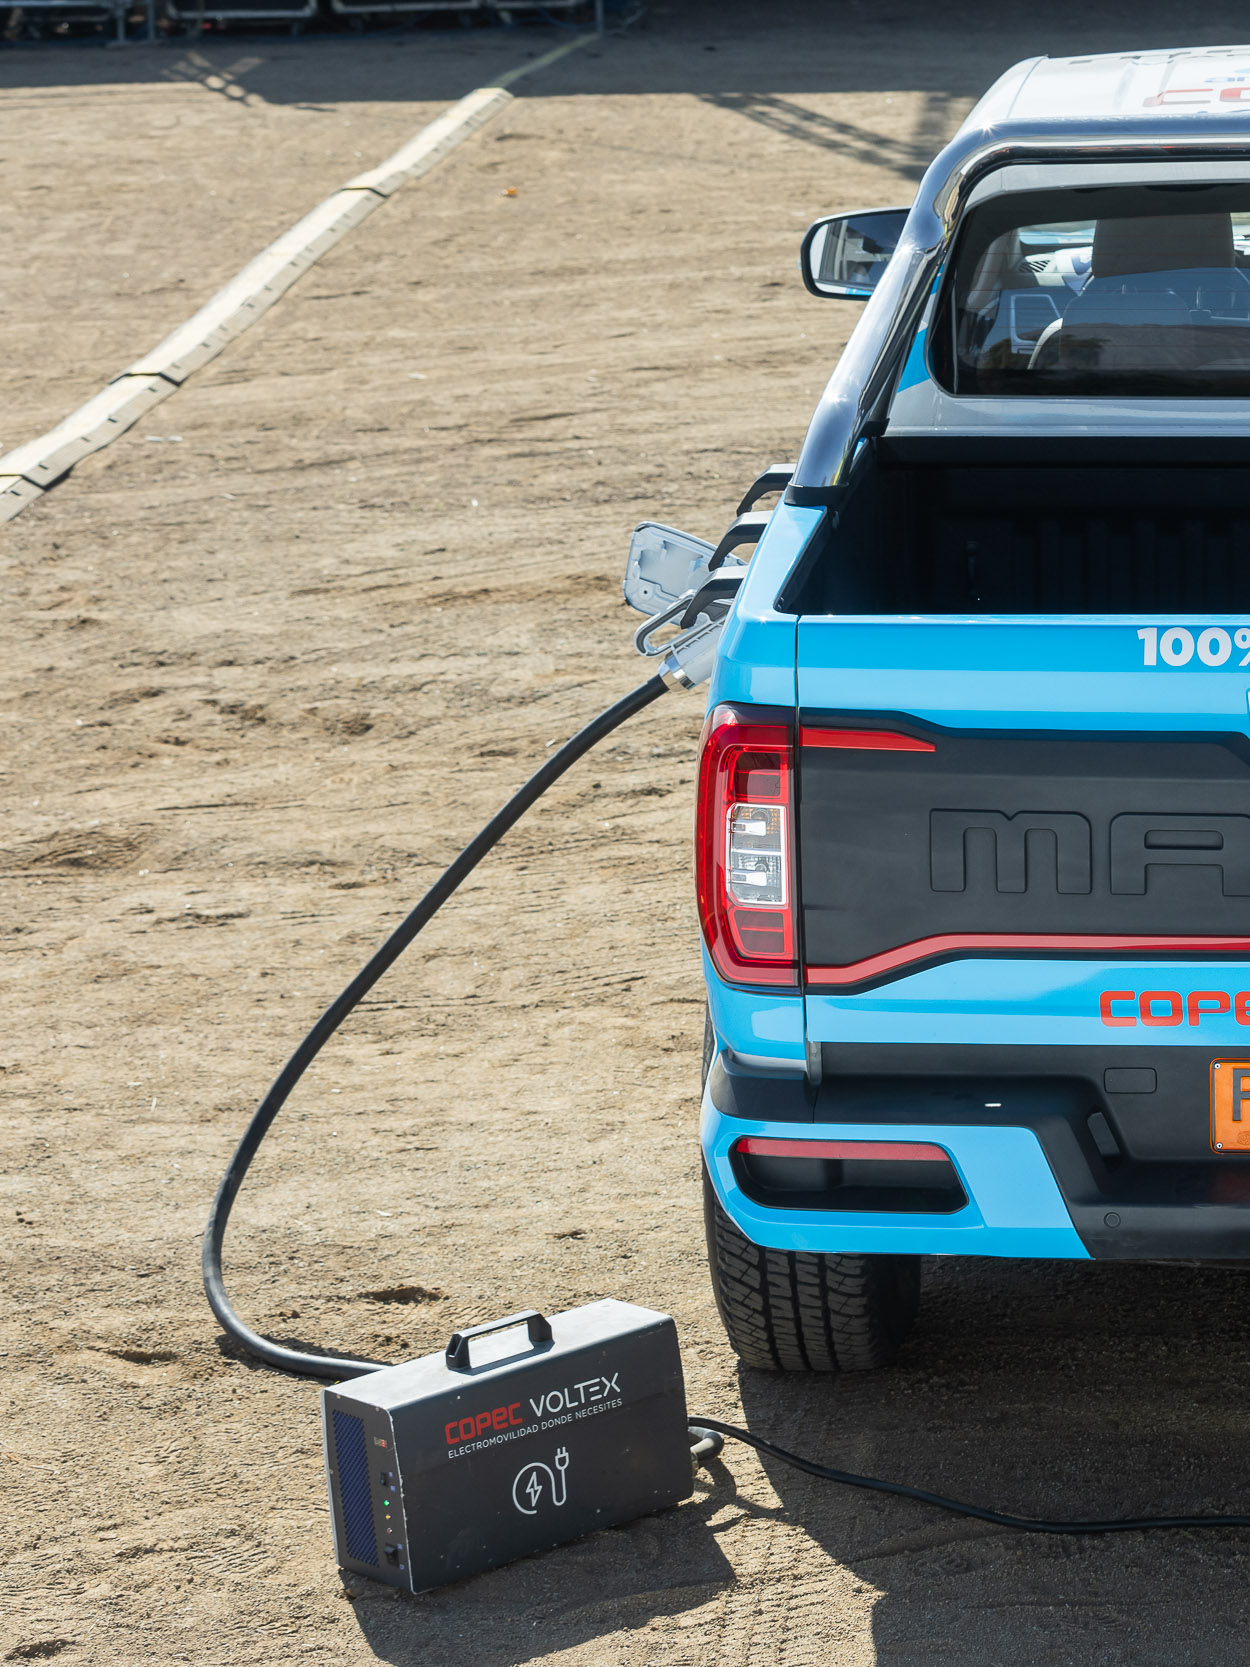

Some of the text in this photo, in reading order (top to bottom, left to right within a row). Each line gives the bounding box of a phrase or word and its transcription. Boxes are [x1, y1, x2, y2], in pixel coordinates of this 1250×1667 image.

[529, 1372, 621, 1417] VOLTEX
[448, 1398, 623, 1459] ELECTROMOVILIDAD DONDE NECESITES
